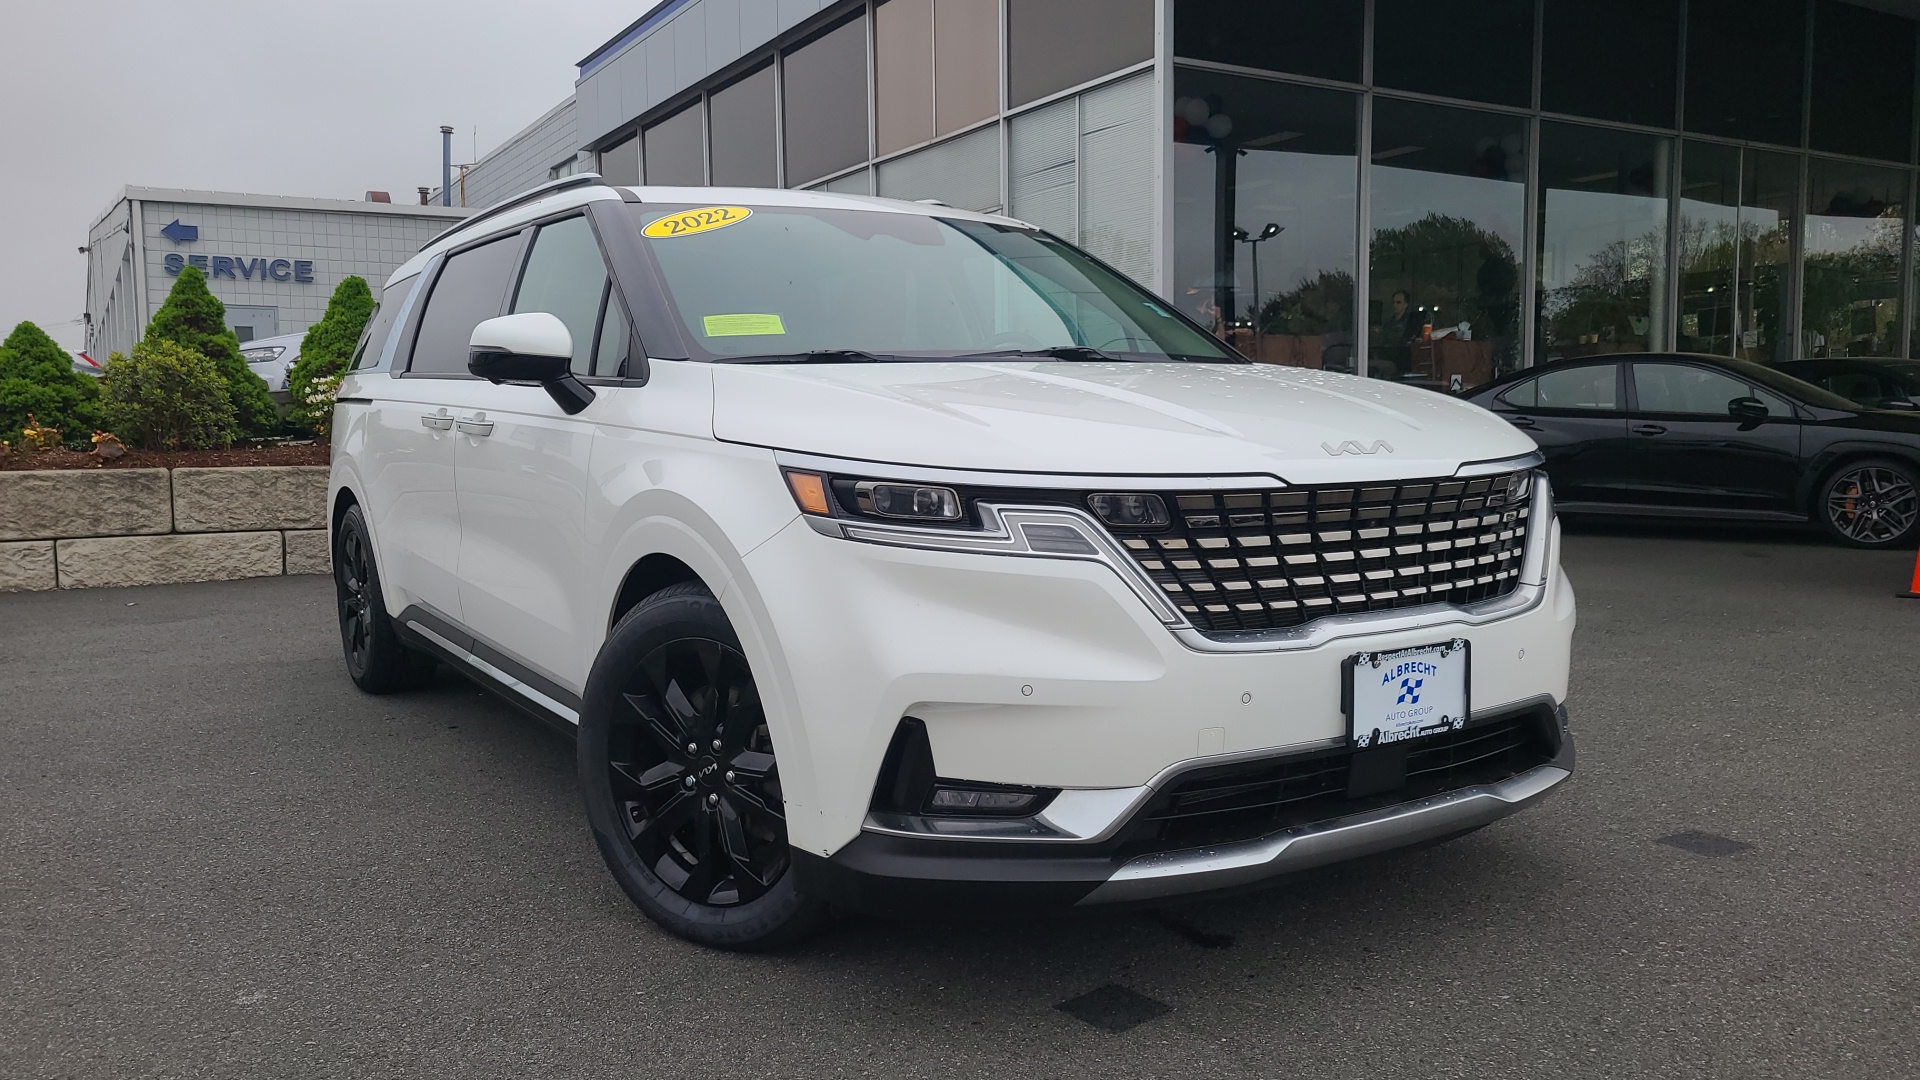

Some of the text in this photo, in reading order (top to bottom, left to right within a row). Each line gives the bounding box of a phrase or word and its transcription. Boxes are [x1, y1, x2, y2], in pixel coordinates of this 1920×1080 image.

[663, 208, 736, 234] 2022
[164, 252, 314, 283] SERVICE
[1382, 662, 1437, 686] ALBRECHT
[1385, 705, 1434, 722] AUTO GROUP
[1377, 726, 1420, 744] Albrecht
[1433, 726, 1449, 734] GROUP
